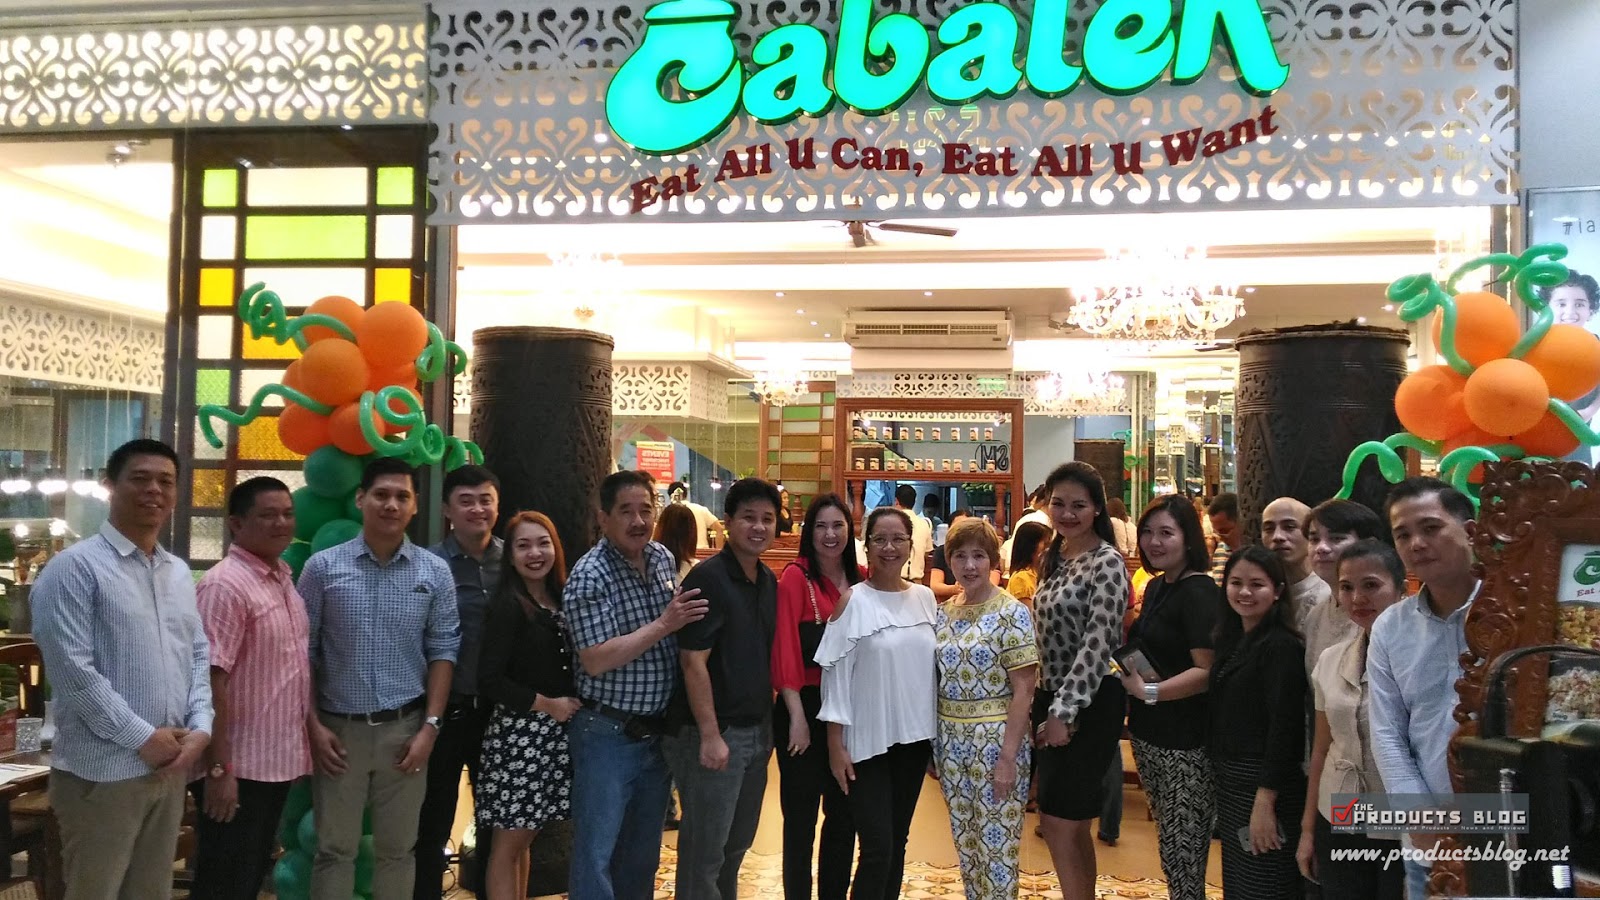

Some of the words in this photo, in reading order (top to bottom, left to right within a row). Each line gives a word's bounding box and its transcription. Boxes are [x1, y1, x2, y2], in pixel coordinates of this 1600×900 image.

[605, 0, 1290, 155] Cabalen
[630, 163, 702, 214] Eat
[714, 143, 772, 183] All
[831, 137, 924, 177] Can,
[942, 142, 1018, 176] Eat
[1030, 143, 1093, 176] All
[1161, 104, 1279, 166] Want
[1577, 588, 1595, 597] Eat
